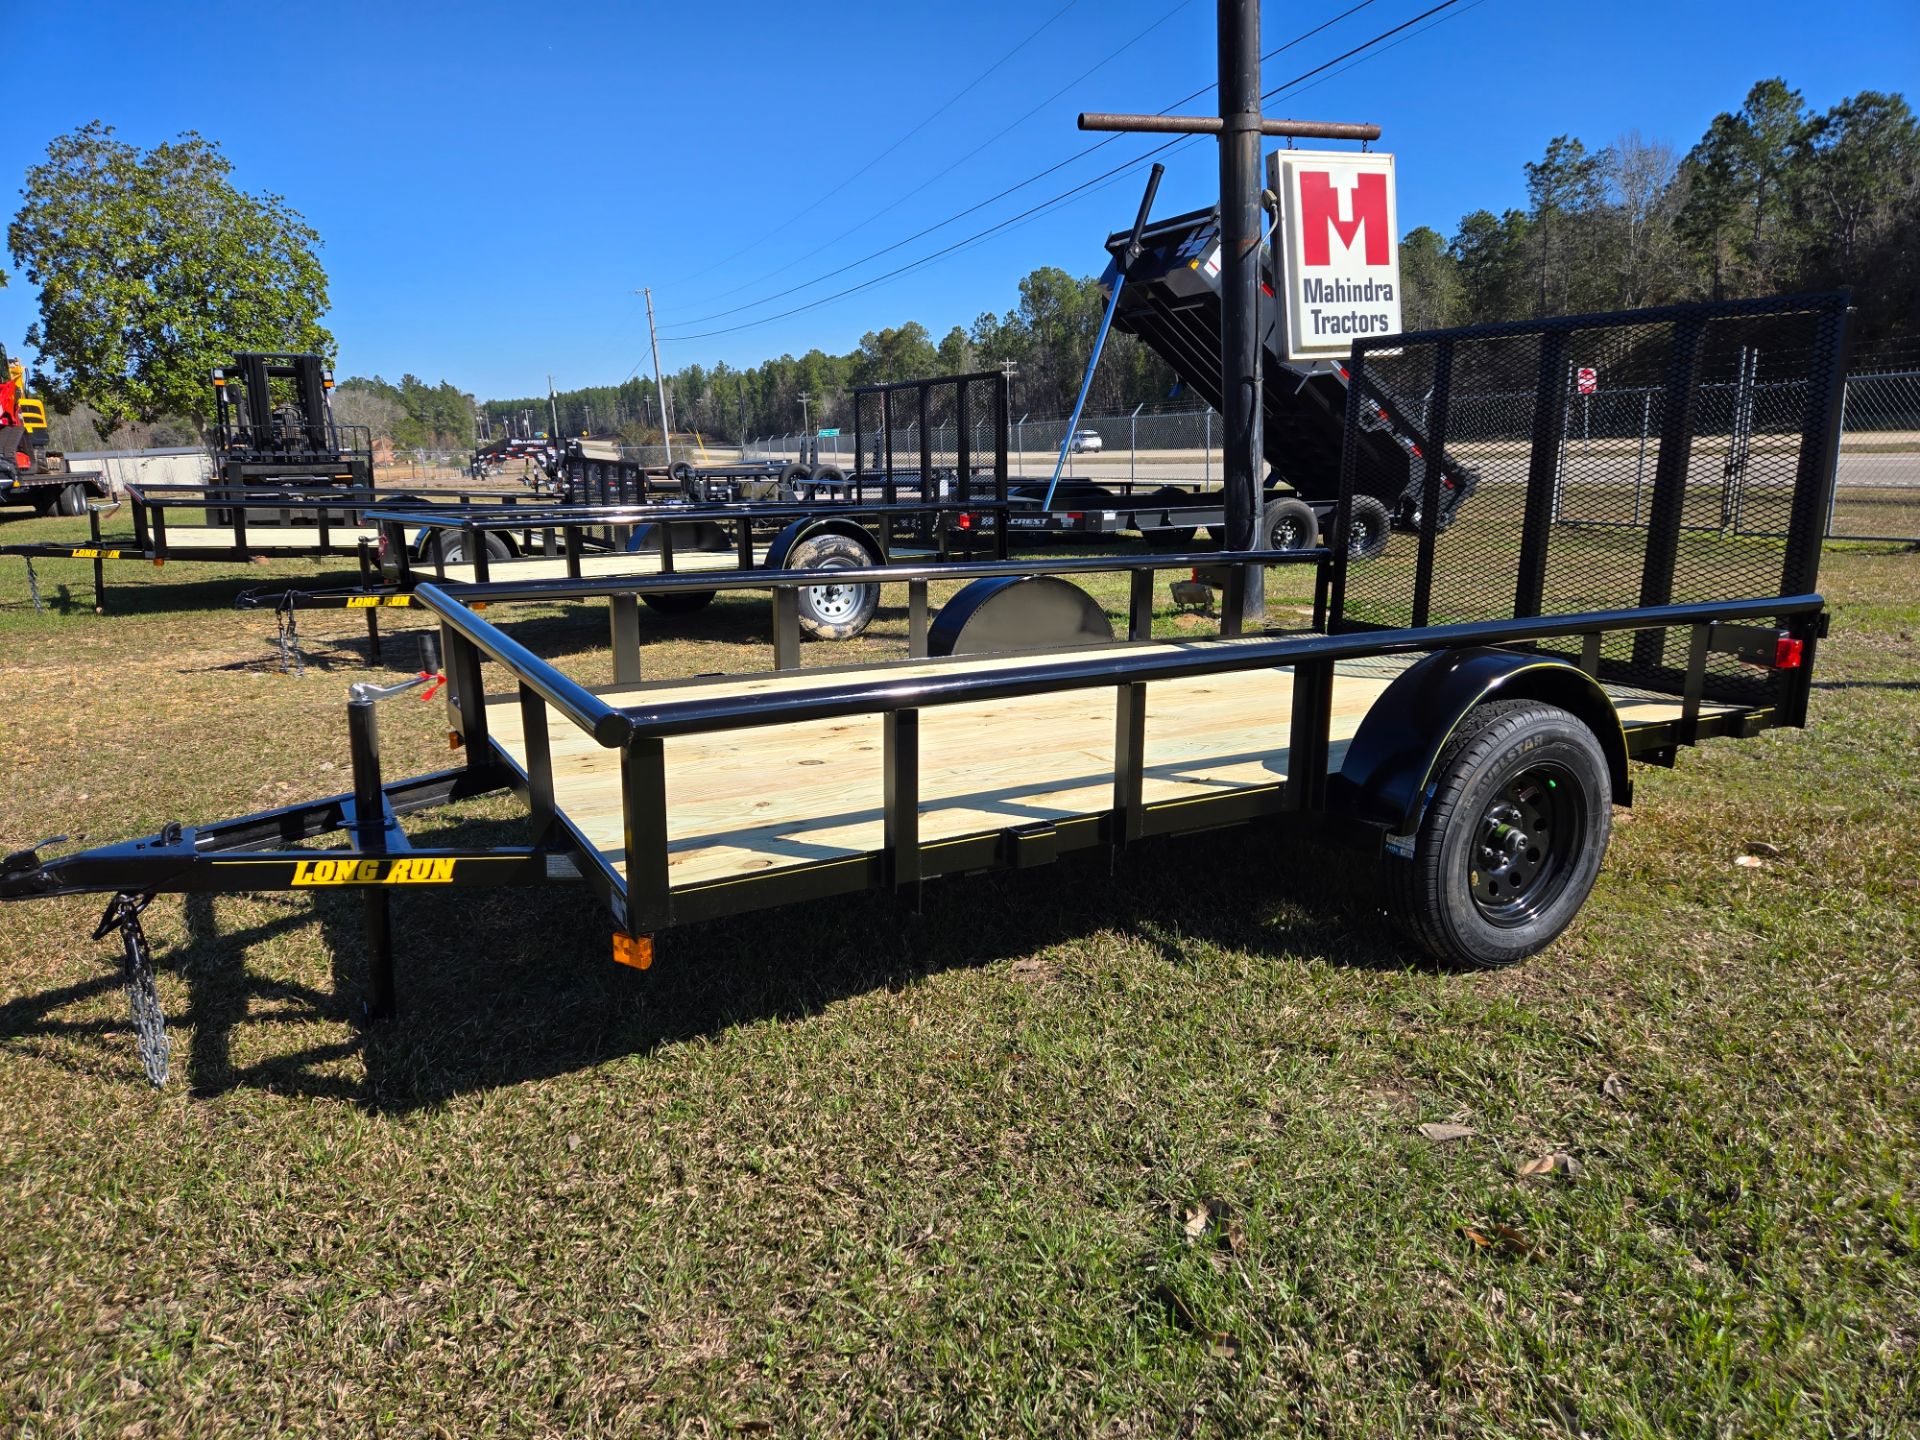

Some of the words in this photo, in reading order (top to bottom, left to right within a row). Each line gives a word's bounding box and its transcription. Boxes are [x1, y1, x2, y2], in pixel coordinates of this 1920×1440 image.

[1303, 277, 1394, 303] Mahindra
[1310, 309, 1389, 334] Tractors
[347, 596, 380, 608] LONG
[291, 860, 380, 885] LONG
[384, 858, 457, 883] RUN
